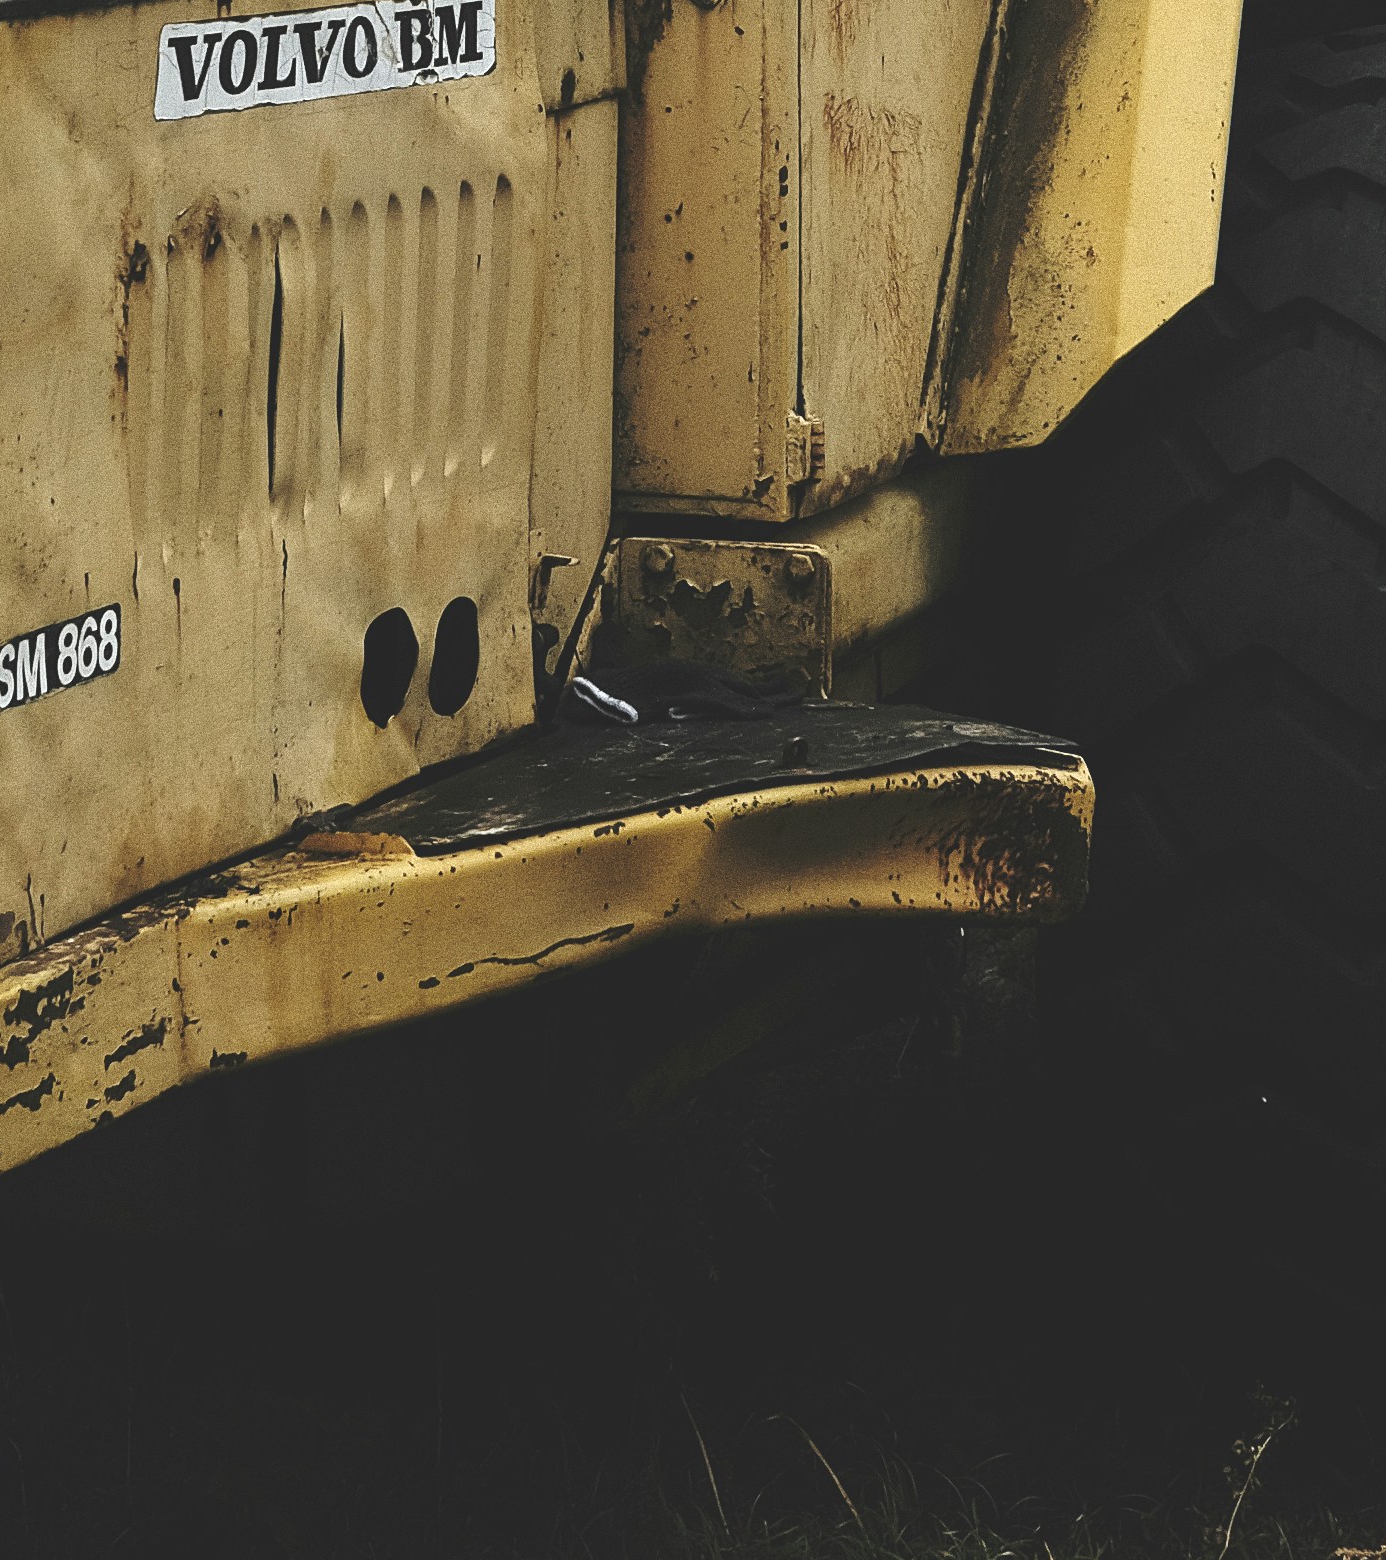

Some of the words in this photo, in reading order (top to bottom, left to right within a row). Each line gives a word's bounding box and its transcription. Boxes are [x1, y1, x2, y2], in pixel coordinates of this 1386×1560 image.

[167, 15, 379, 102] VOLVO
[394, 0, 485, 73] BM
[56, 609, 119, 686] 868
